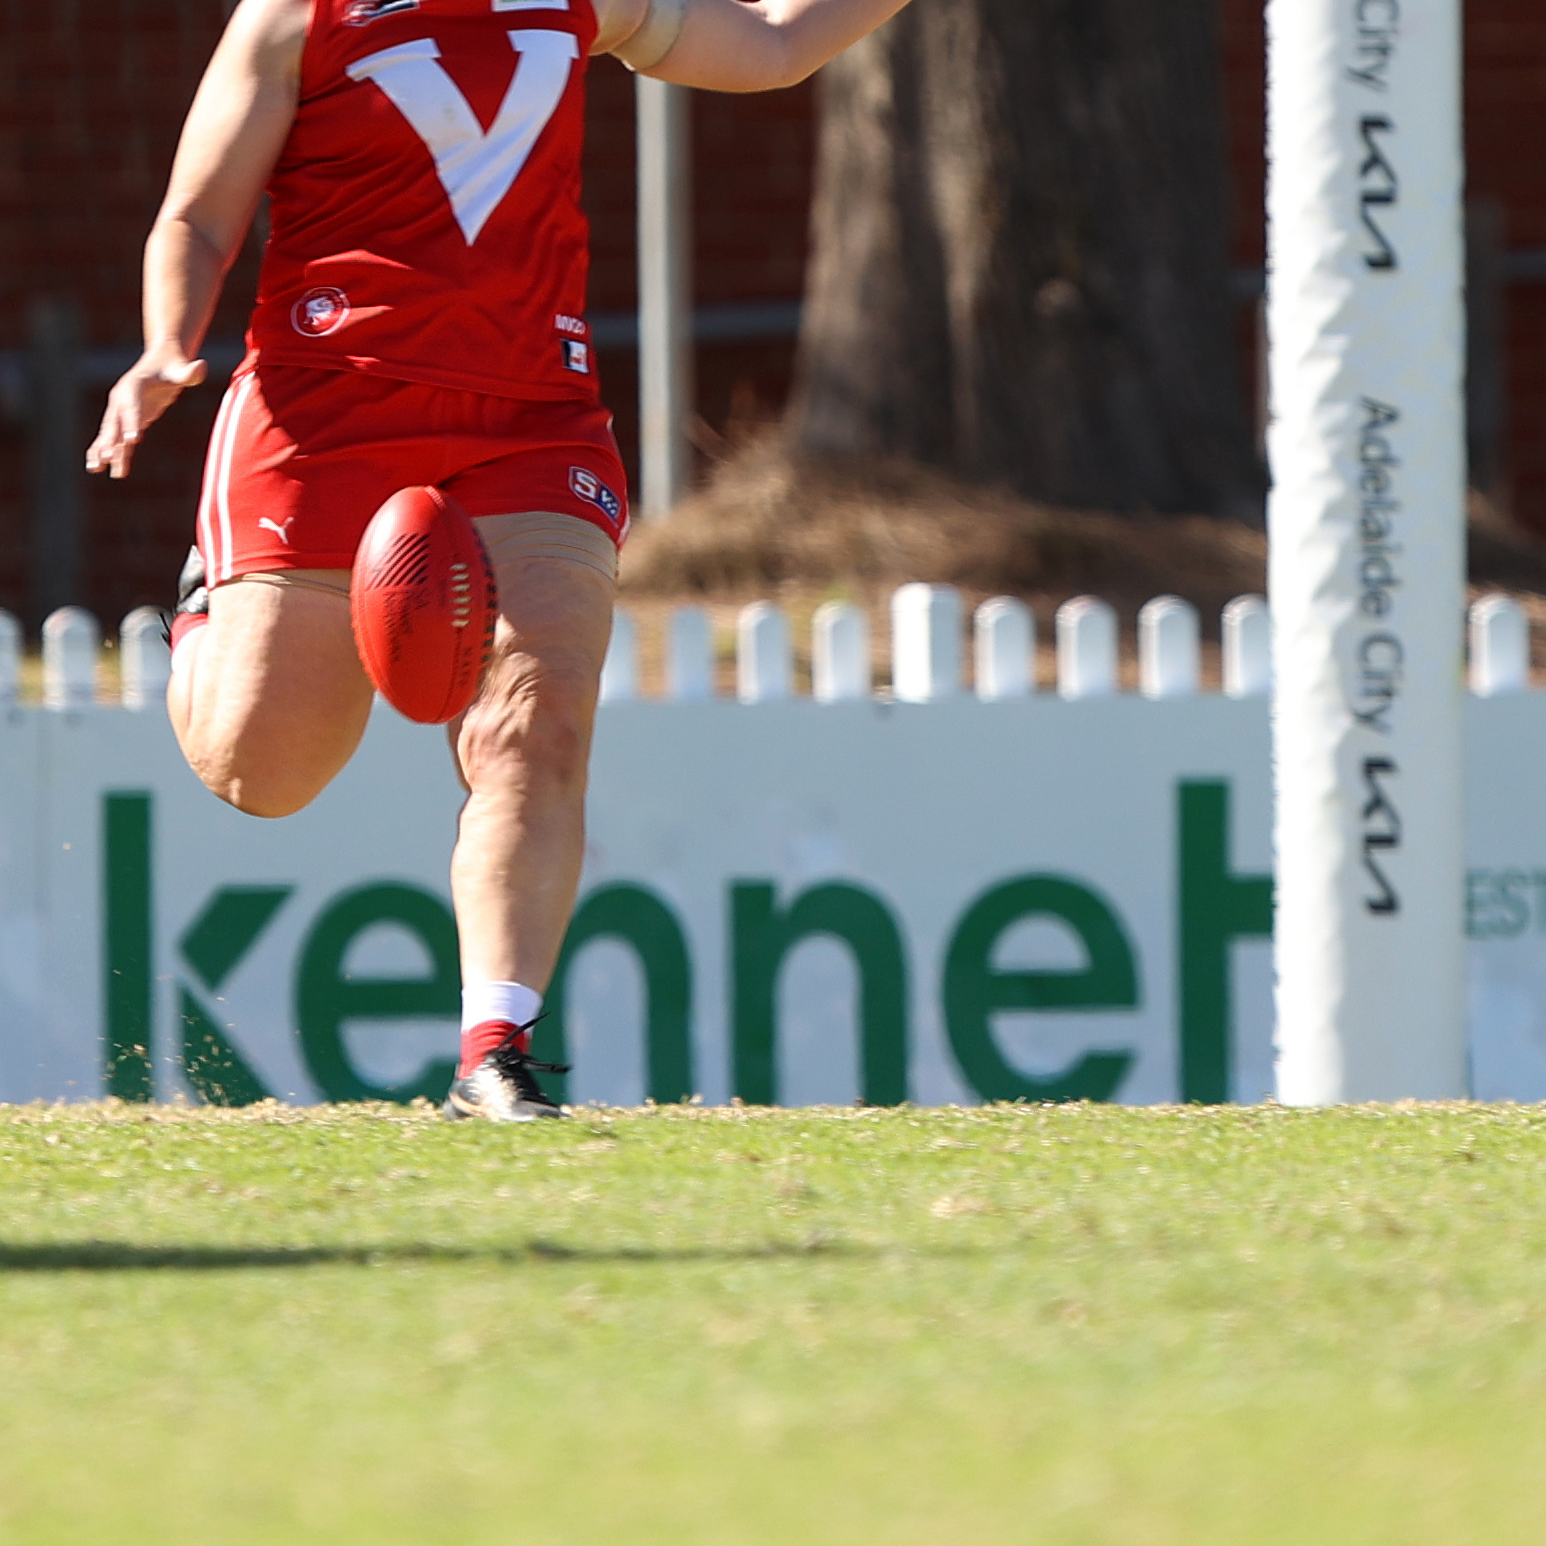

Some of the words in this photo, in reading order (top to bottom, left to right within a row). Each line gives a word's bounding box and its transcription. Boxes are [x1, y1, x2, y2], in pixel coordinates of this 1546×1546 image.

[345, 28, 581, 247] V
[1359, 394, 1402, 618] Adelaide
[1352, 632, 1405, 738] City
